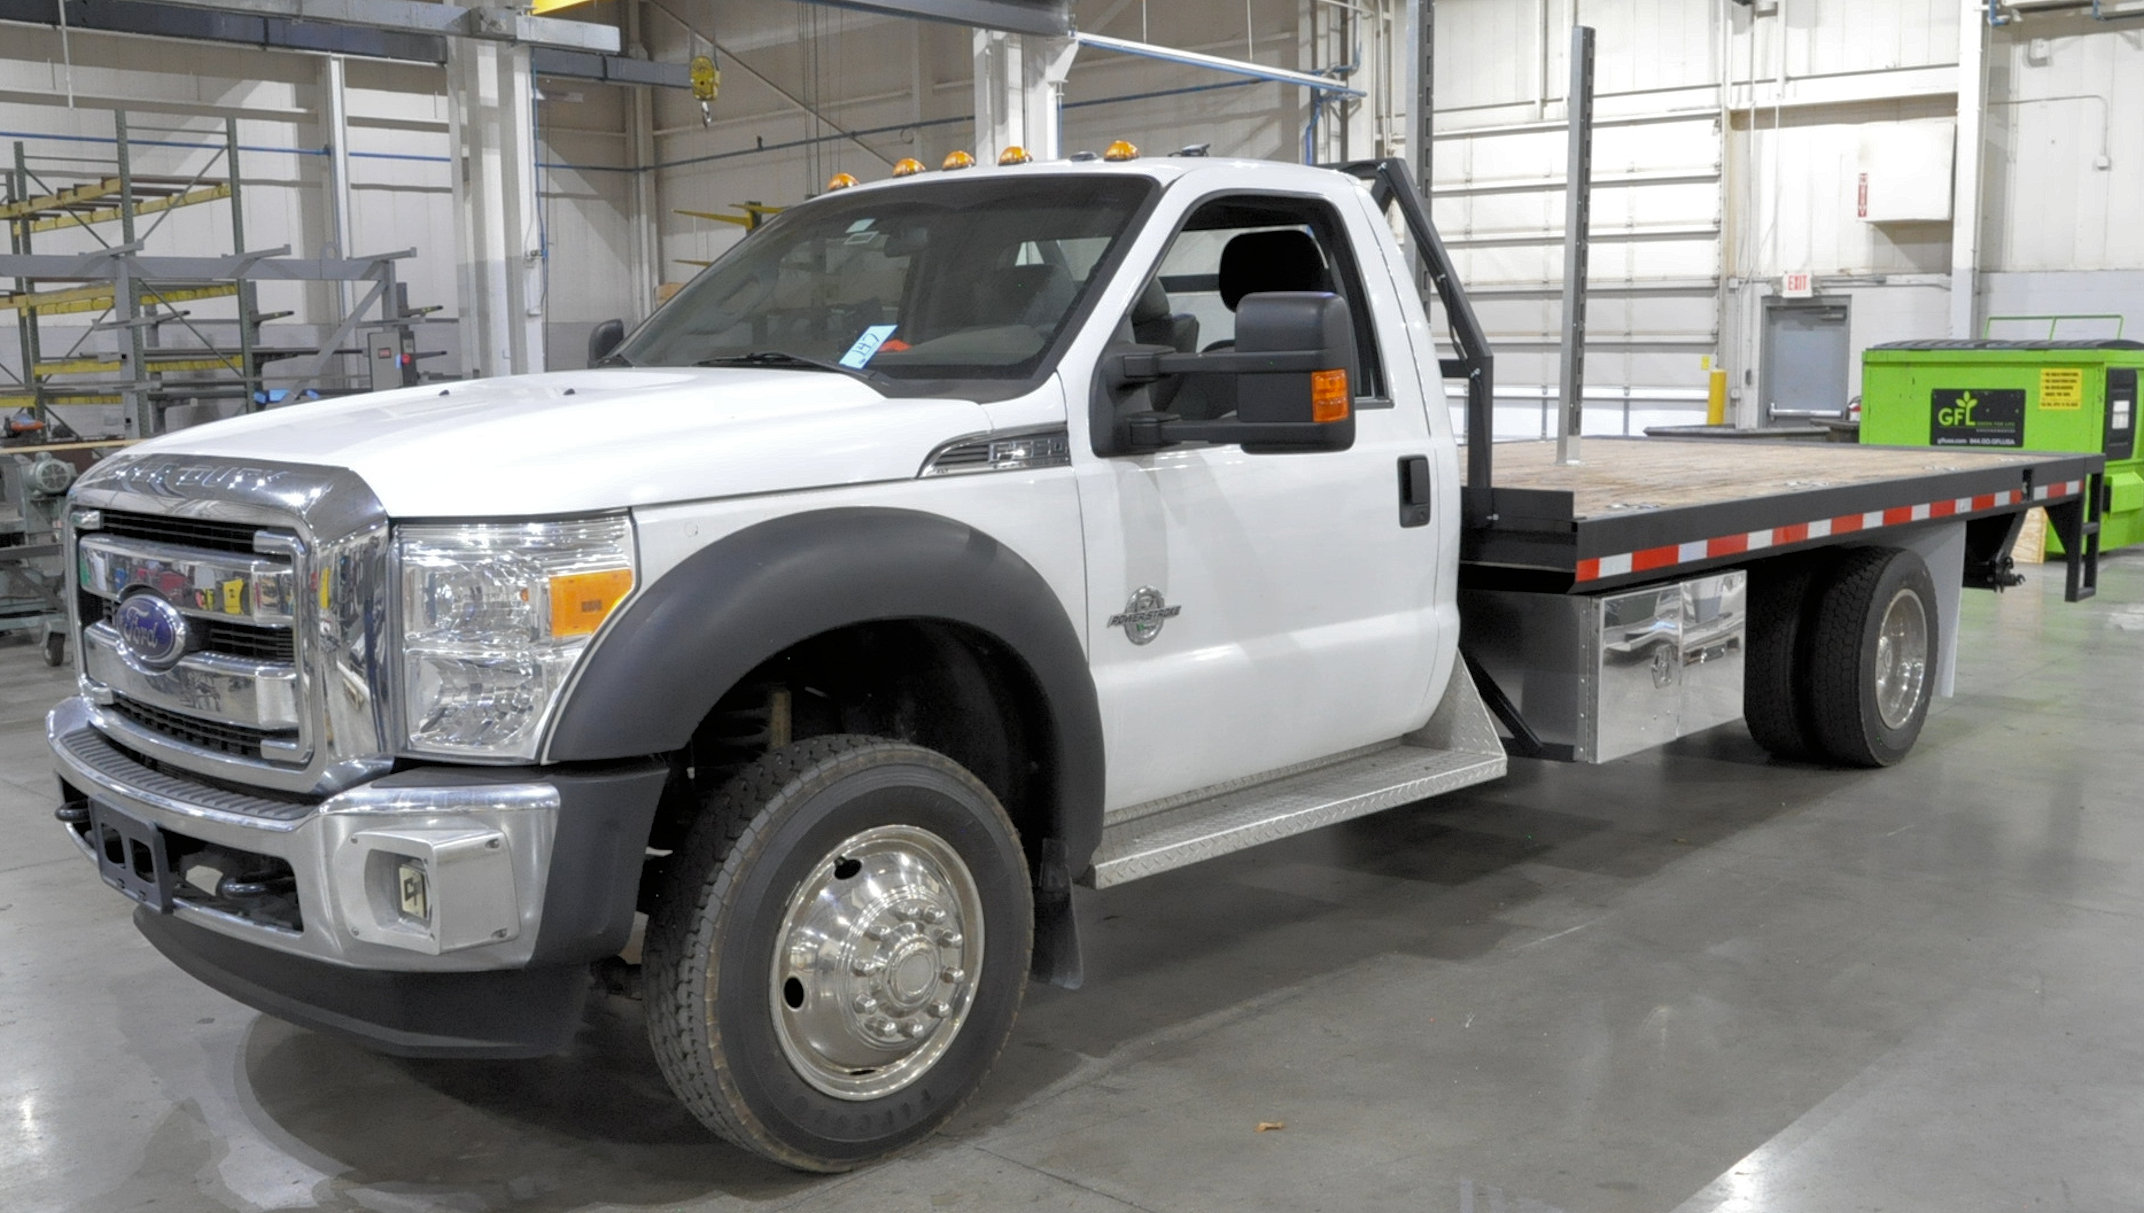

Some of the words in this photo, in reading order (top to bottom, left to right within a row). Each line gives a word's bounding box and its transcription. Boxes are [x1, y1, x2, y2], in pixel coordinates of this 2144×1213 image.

[1788, 275, 1807, 291] EXIT
[1938, 402, 1976, 427] GFL
[123, 606, 159, 648] Ford
